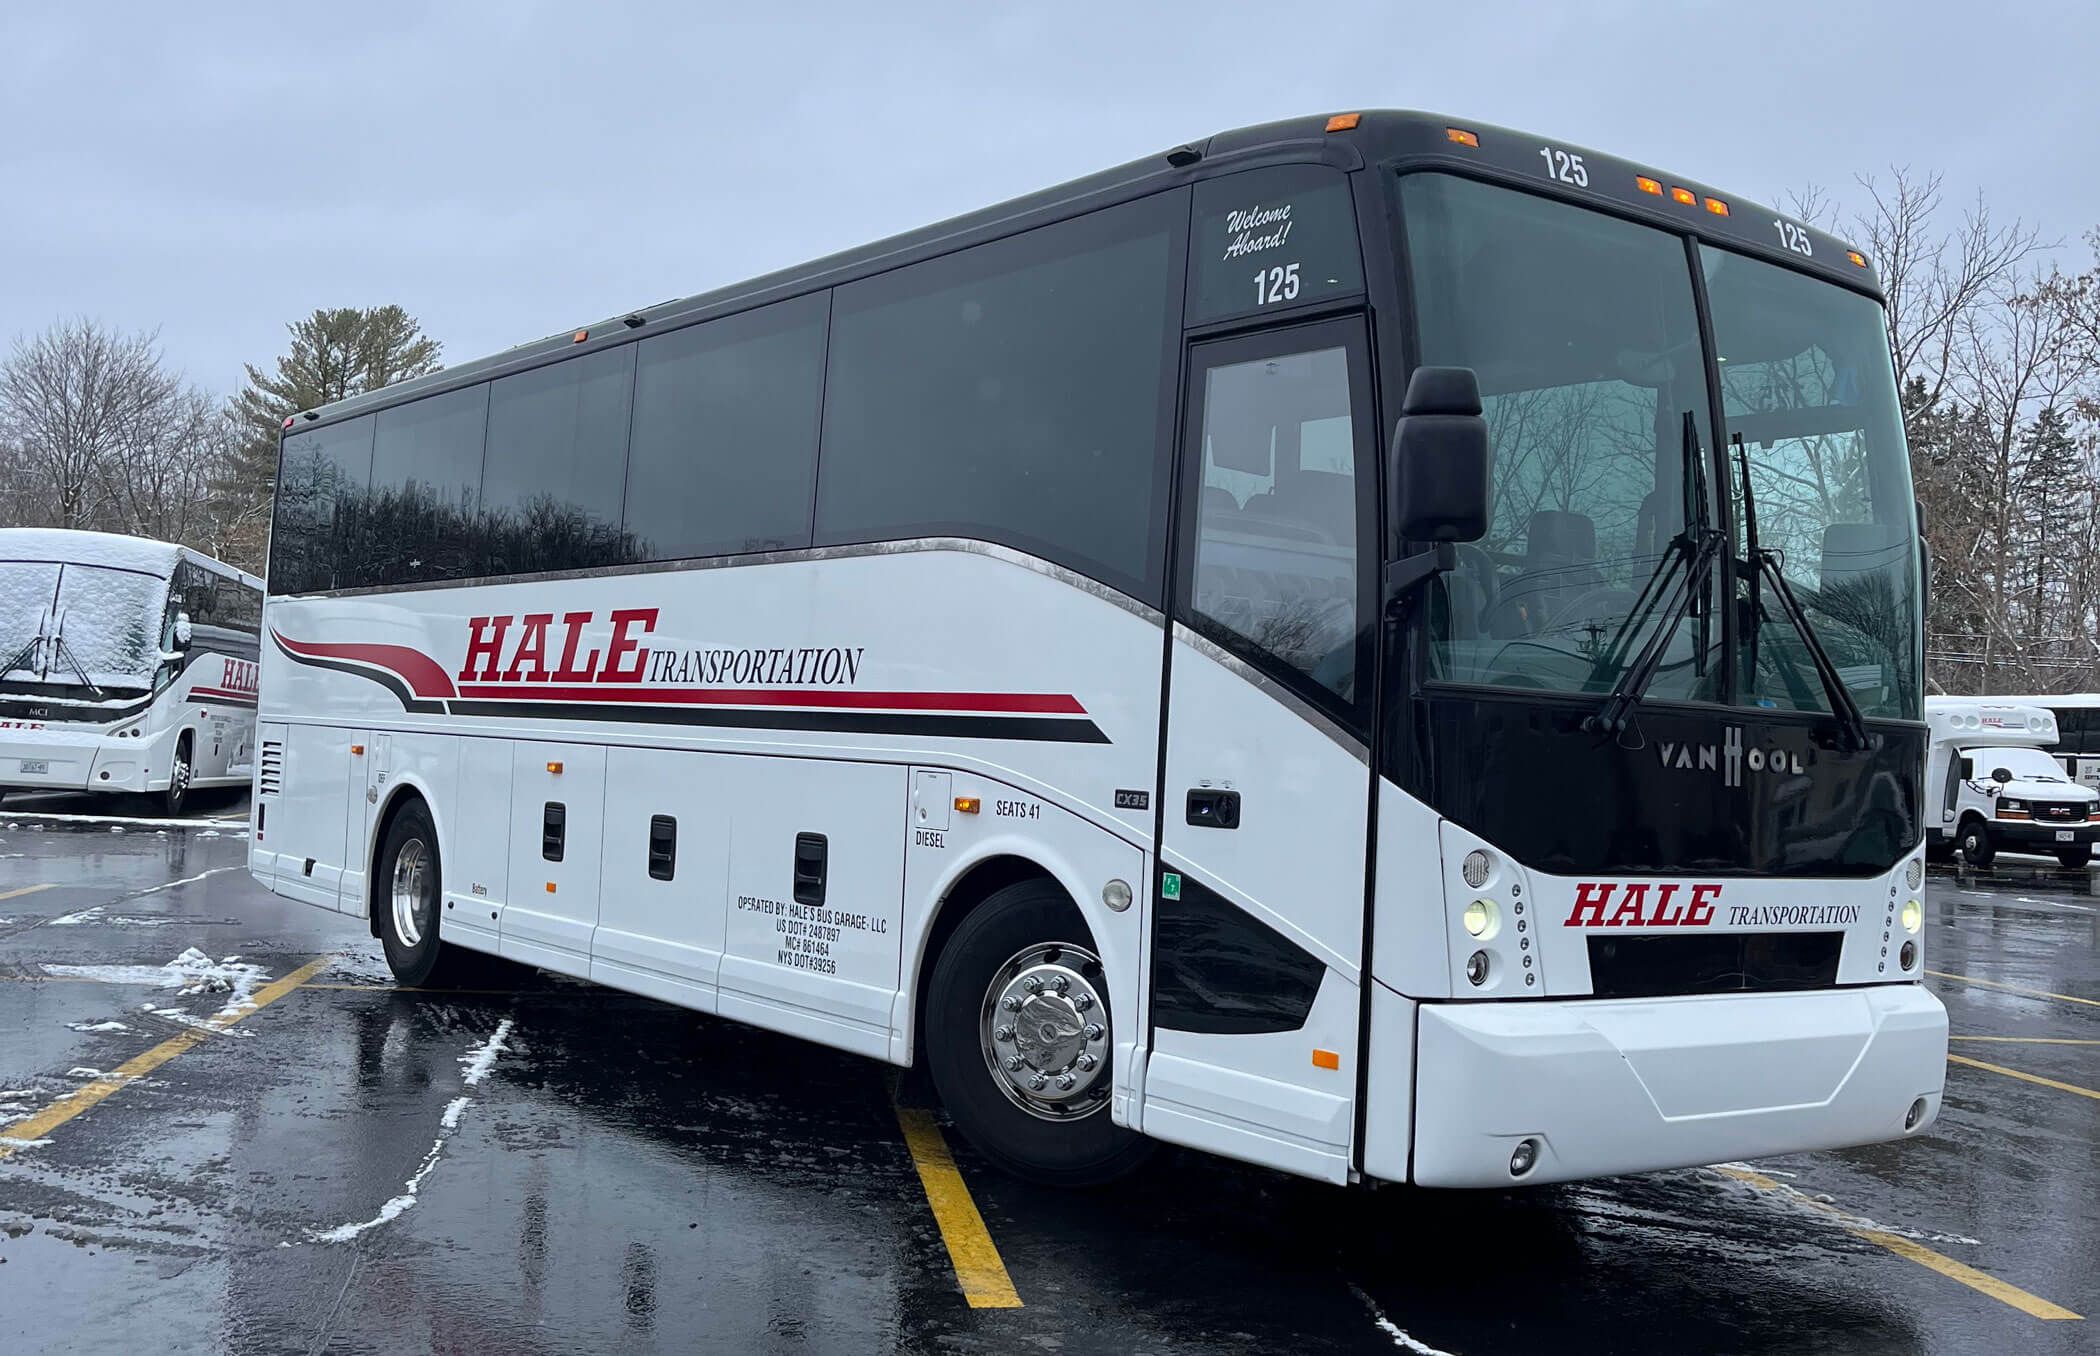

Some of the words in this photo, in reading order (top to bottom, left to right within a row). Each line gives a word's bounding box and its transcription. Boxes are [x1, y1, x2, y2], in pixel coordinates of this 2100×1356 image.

[1539, 147, 1588, 188] 125
[1226, 204, 1292, 234] Welcome
[1223, 220, 1293, 261] Aboard!
[1773, 219, 1813, 256] 125
[1254, 262, 1300, 305] 125
[457, 608, 660, 684] HALE
[648, 647, 865, 686] TRANSPORTATION
[29, 708, 48, 717] MCI
[996, 800, 1026, 818] SEATS
[1029, 804, 1040, 819] 41
[1117, 793, 1148, 807] CX35
[916, 831, 945, 848] DIESEL
[737, 896, 774, 914] OPERATED
[775, 902, 787, 917] BY:
[817, 908, 832, 925] BUS
[871, 917, 887, 934] LLC
[1563, 883, 1722, 927] HALE
[1728, 904, 1861, 926] TRANSPORTATION
[776, 918, 786, 933] US
[788, 921, 807, 936] DOT#
[808, 924, 841, 943] 2487897
[785, 935, 800, 951] MC#
[777, 949, 793, 966] NYS
